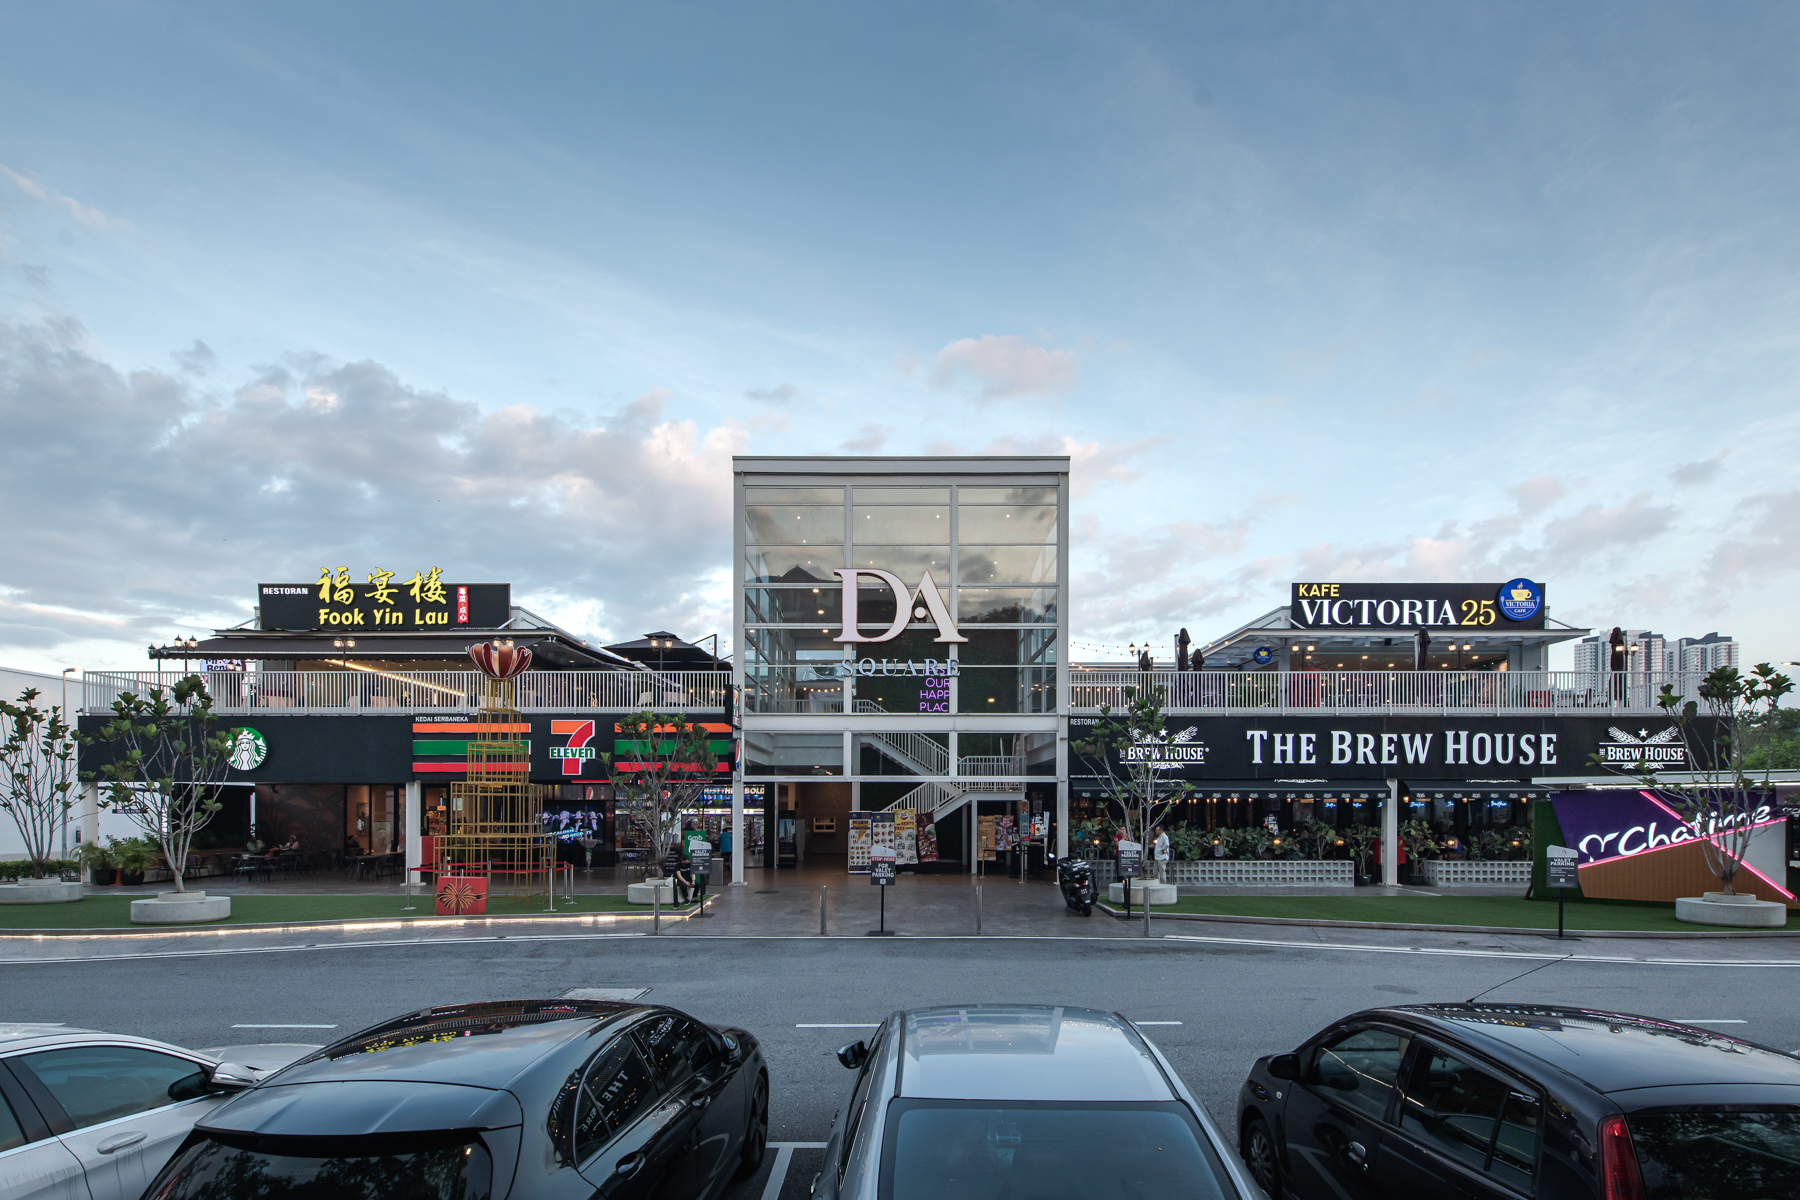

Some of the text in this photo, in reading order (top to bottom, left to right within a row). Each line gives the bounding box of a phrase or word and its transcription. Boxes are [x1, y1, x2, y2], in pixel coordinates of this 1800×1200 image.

[262, 587, 308, 595] RESTORAN
[315, 566, 447, 605] 福宴楼
[1299, 584, 1340, 597] KAFE
[833, 568, 969, 642] DA
[1299, 599, 1496, 625] VICTORIA 25
[318, 607, 449, 625] Fook Yin Lau
[841, 657, 961, 677] SQUARE
[925, 677, 950, 688] OUR
[920, 689, 950, 699] HAPP
[919, 702, 949, 713] PLAC
[1246, 730, 1557, 765] THE BREW HOUSE
[1607, 746, 1643, 760] BREW
[1644, 746, 1685, 760] HOUSE
